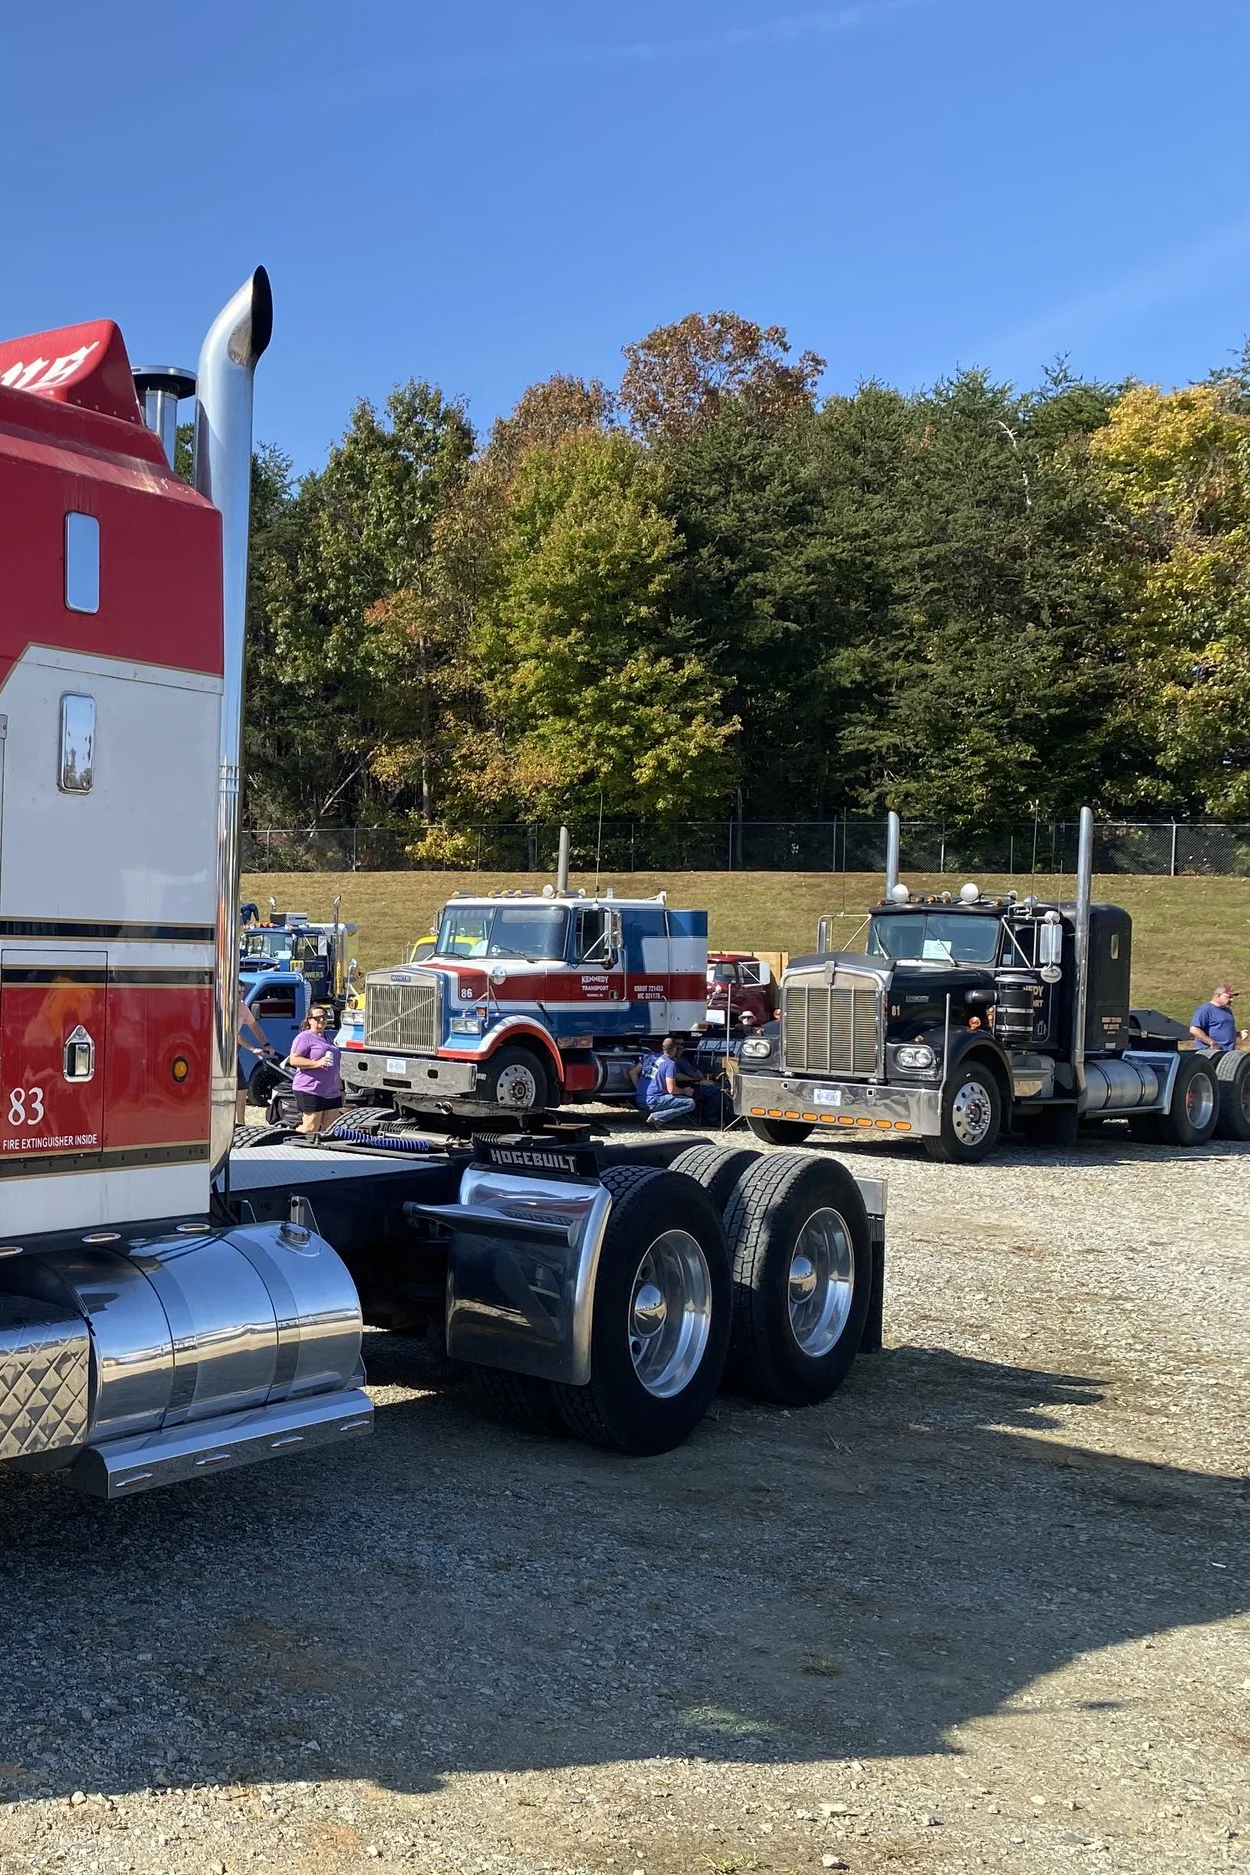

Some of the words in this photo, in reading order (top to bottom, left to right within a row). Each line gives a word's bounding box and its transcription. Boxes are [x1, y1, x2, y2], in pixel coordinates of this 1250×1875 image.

[581, 976, 609, 984] KENNEDY
[460, 988, 473, 998] 86
[892, 1005, 900, 1016] 81
[8, 1087, 45, 1126] 83
[2, 1139, 20, 1150] FIRE
[21, 1136, 74, 1150] EXTINGUISHER
[74, 1134, 98, 1146] INSIDE
[490, 1149, 575, 1172] HOGEBUILT
